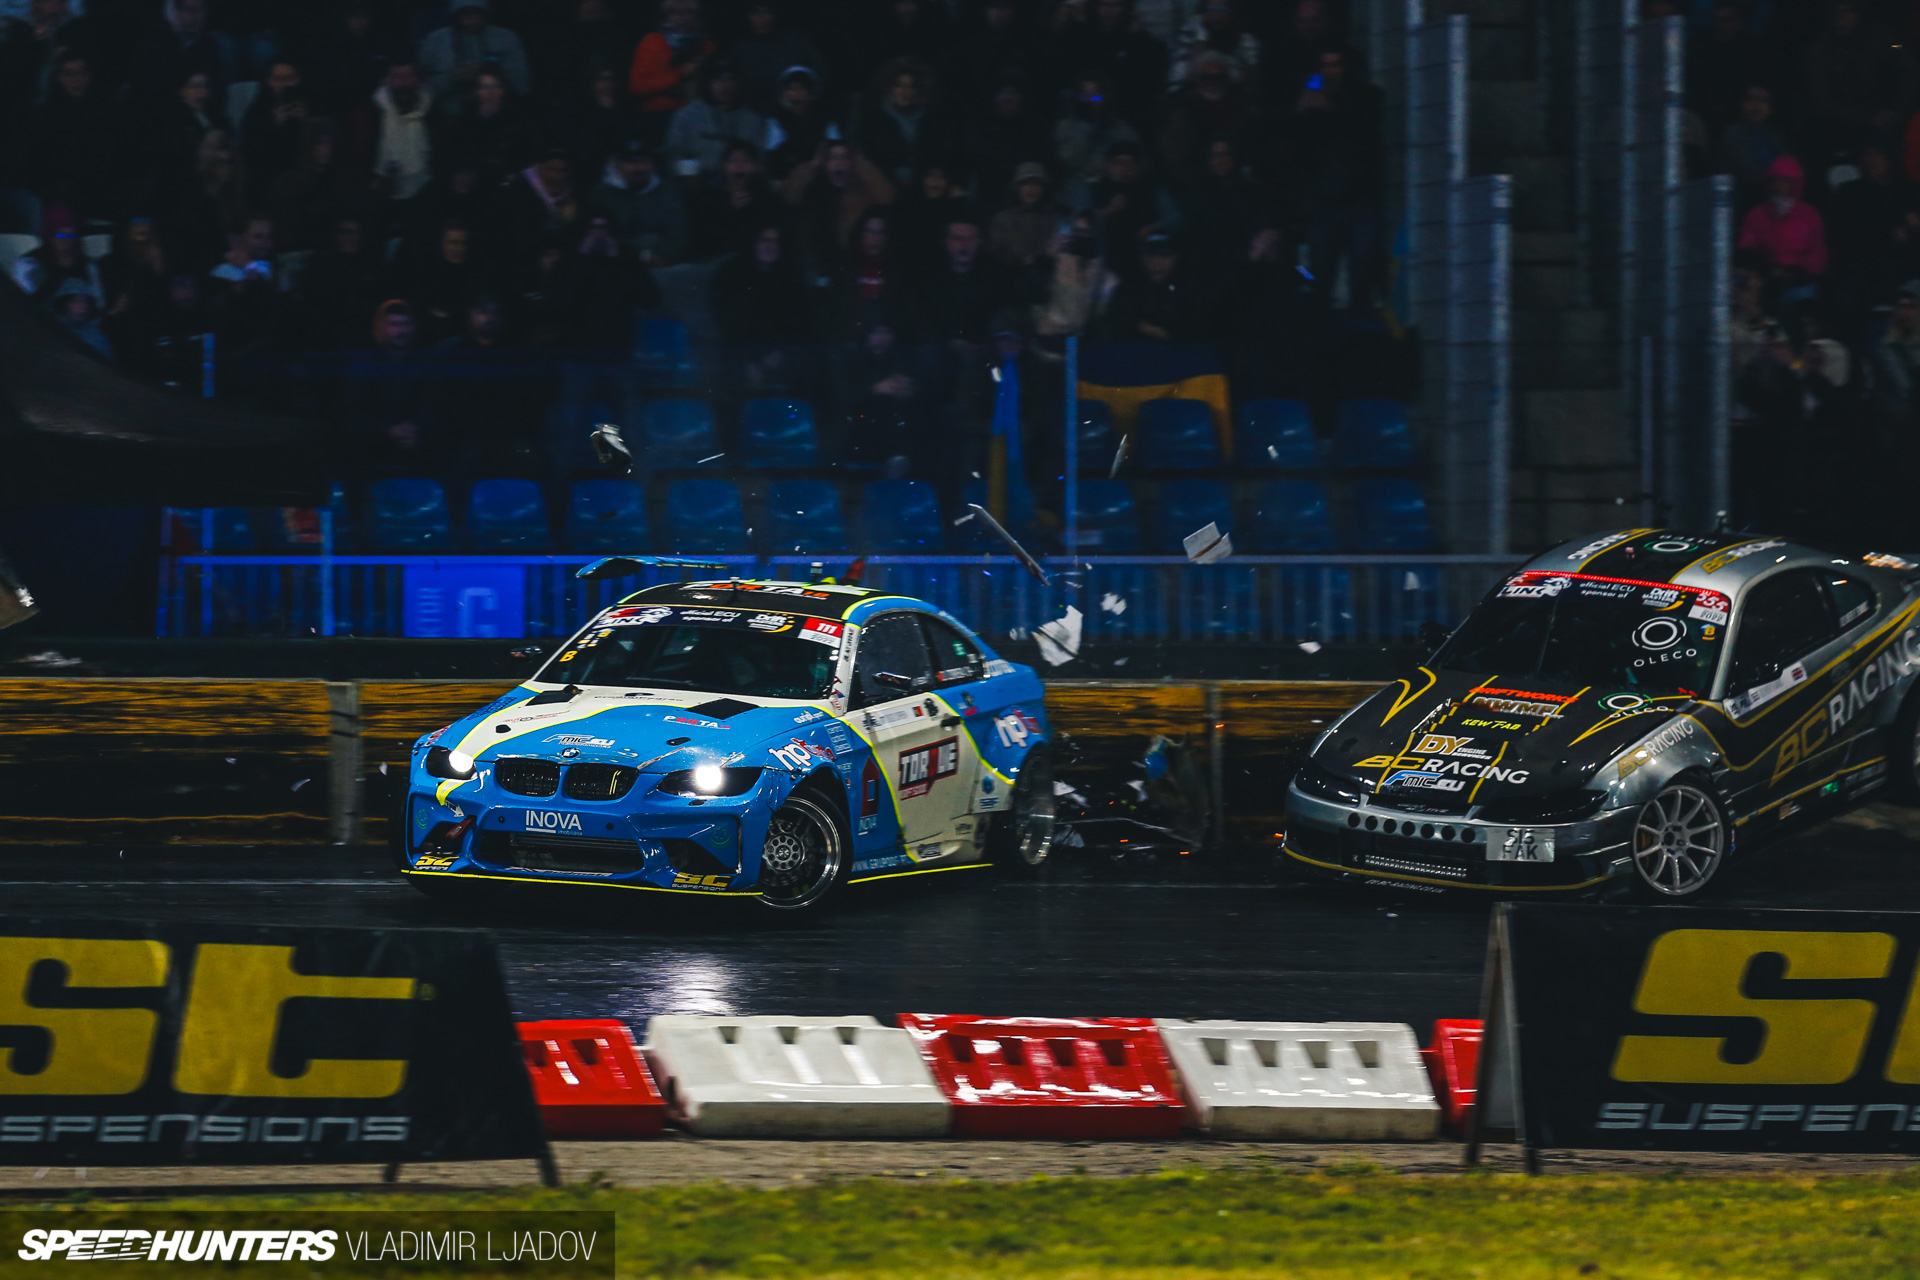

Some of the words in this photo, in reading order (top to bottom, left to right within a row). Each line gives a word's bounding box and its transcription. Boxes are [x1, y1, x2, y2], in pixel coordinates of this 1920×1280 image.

[1579, 581, 1611, 590] official
[1611, 584, 1637, 593] ECU
[1580, 589, 1616, 598] sponsor
[1650, 587, 1680, 599] Drift
[816, 622, 838, 634] 111
[558, 650, 579, 663] B
[1633, 648, 1697, 667] OLECO
[1468, 686, 1579, 703] DRIFTWORKS
[1609, 705, 1669, 718] OLECO
[1411, 734, 1475, 756] DY
[526, 810, 582, 832] INOVA
[1595, 1103, 1920, 1131] SUSPEN
